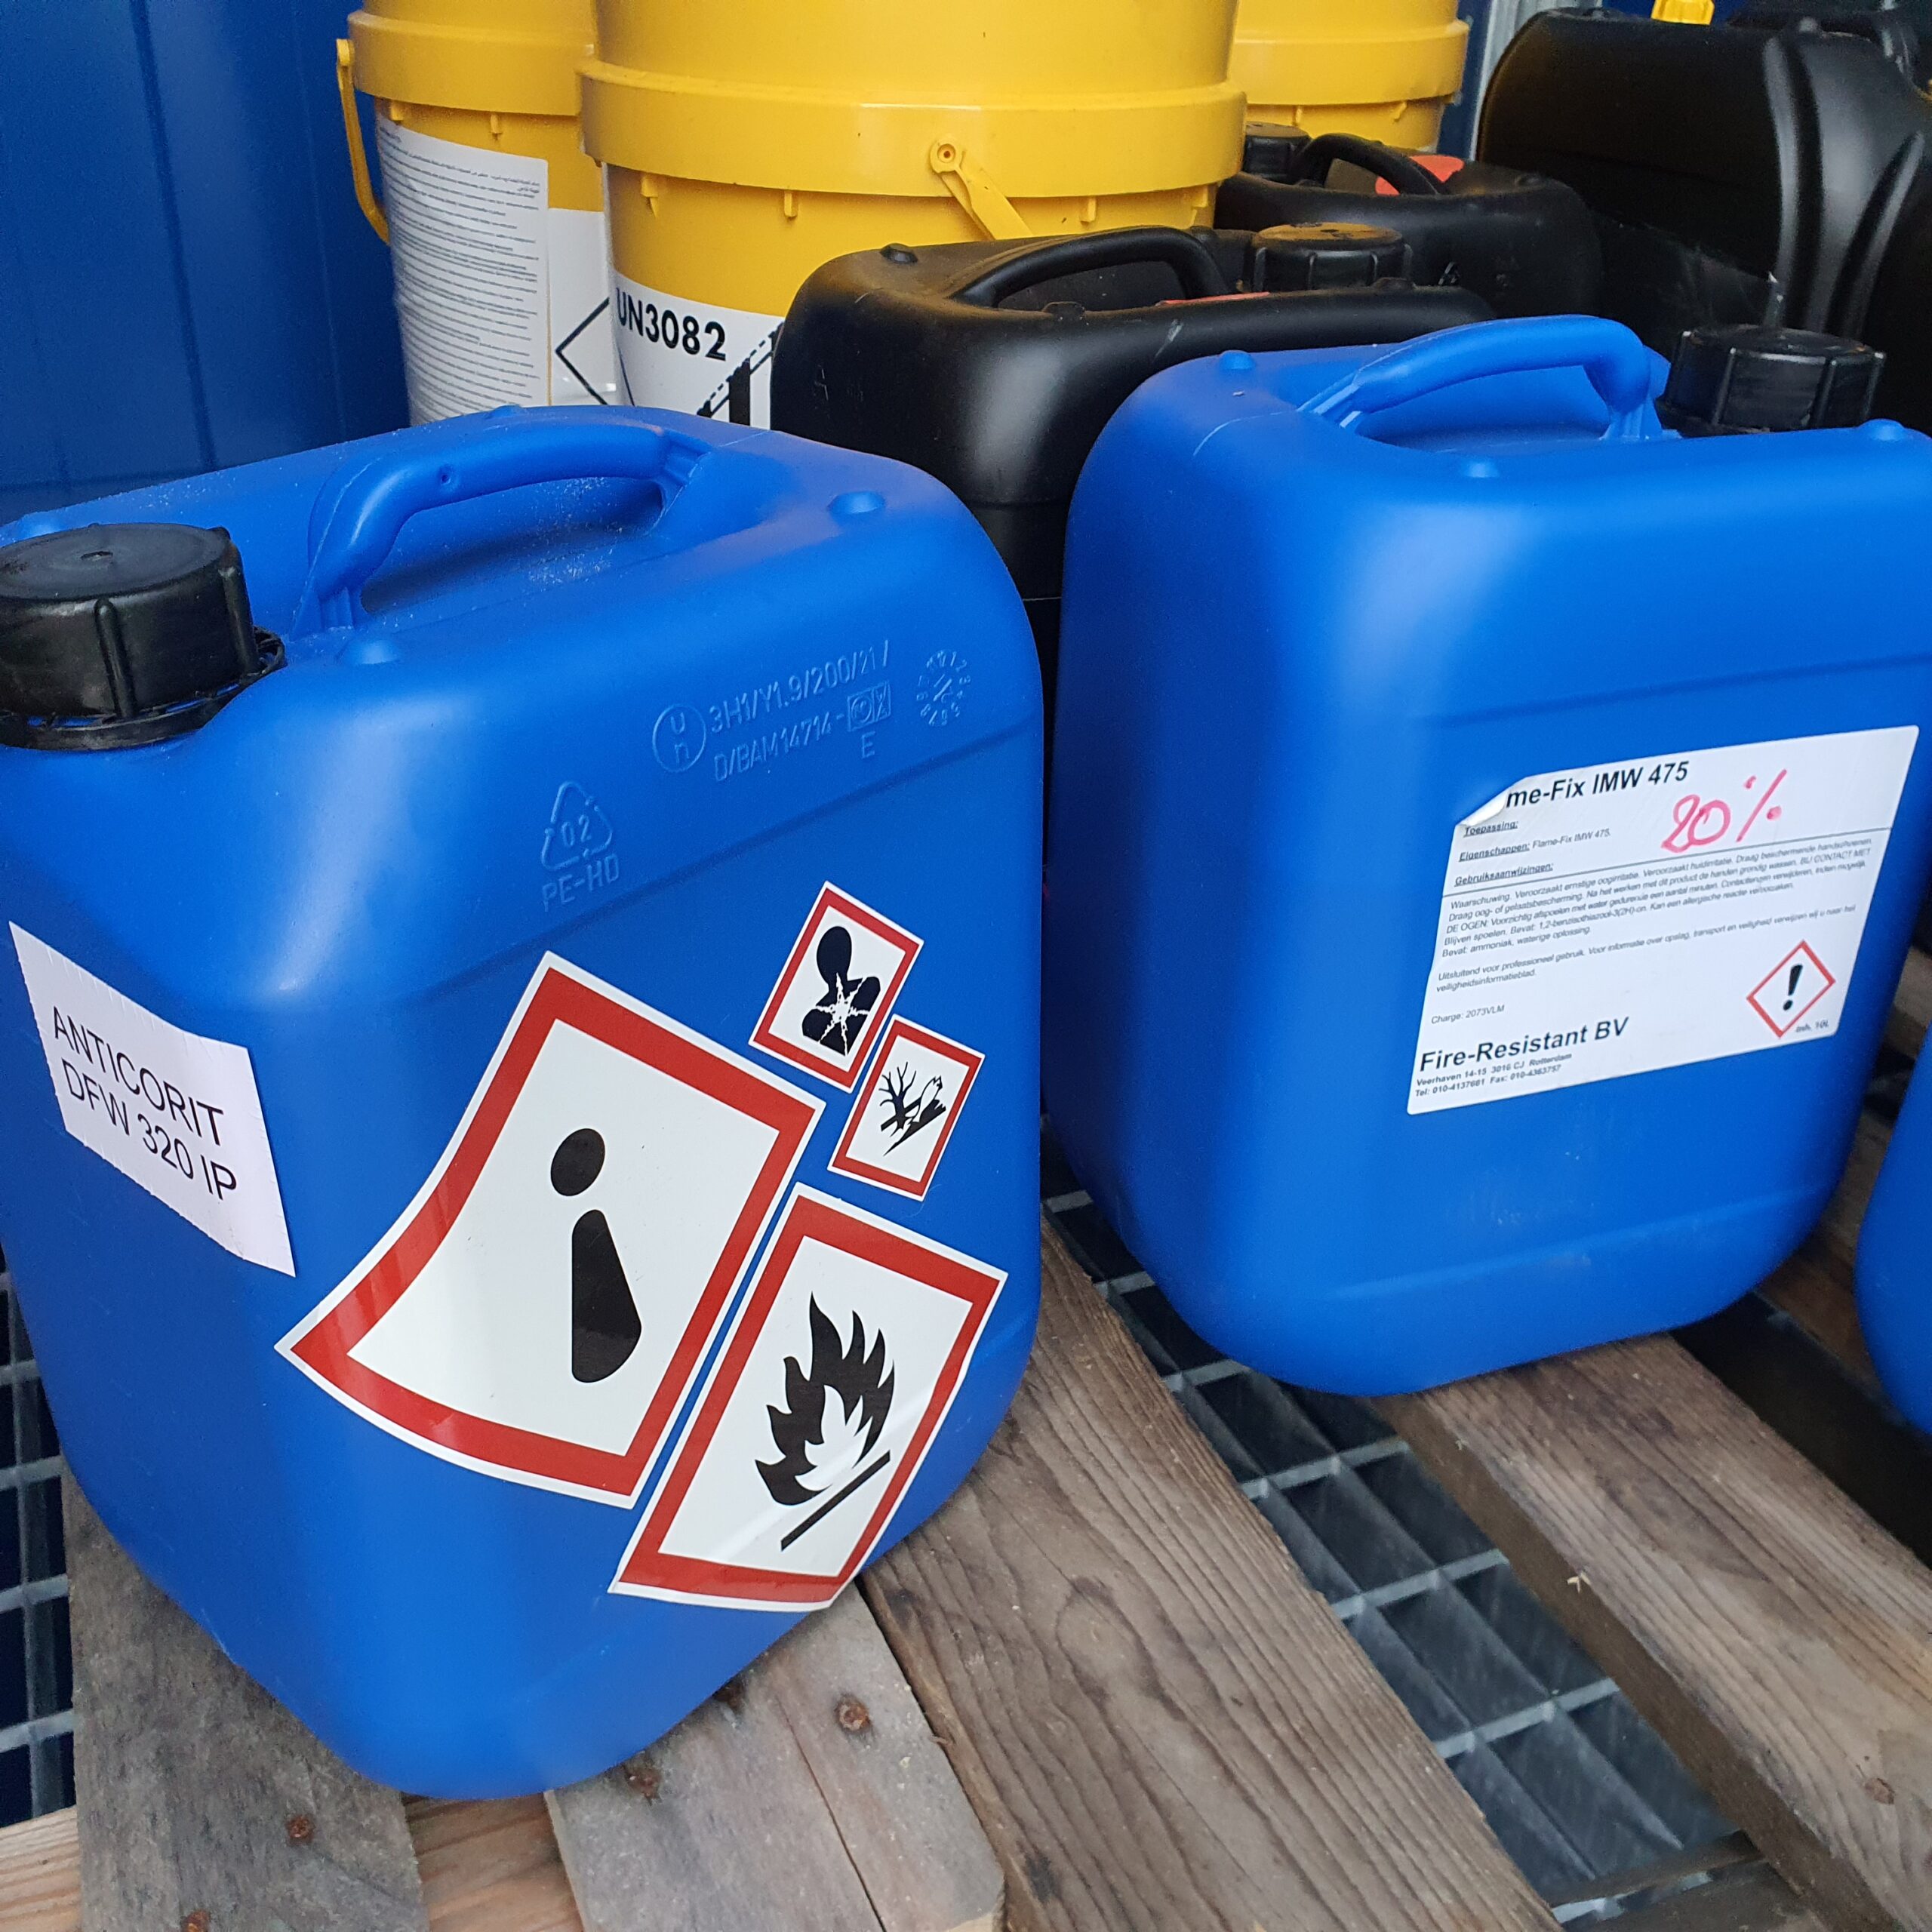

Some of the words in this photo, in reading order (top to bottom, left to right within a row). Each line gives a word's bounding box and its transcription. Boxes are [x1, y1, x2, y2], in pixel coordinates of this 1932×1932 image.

[616, 287, 726, 361] UN3082
[1506, 778, 1585, 808] me-Fix
[1592, 767, 1643, 794] IMW
[1648, 761, 1689, 785] 475
[561, 814, 590, 848] 02
[1464, 821, 1518, 837] Toepassing:
[1458, 843, 1530, 862] Eigenschappen:
[1532, 835, 1573, 849] Flame-Fix
[1574, 832, 1592, 842] IMW
[542, 854, 620, 912] PE-HD
[1454, 863, 1554, 888] Gebruiksaanwijzingen:
[1432, 1012, 1463, 1024] Charge:
[1466, 1004, 1505, 1019] 2073VLM
[1420, 1025, 1588, 1072] Fire-Resistant
[1594, 1017, 1629, 1040] BV
[54, 1006, 223, 1146] ANTICORIT
[1417, 1073, 1462, 1086] Veerhaven
[1465, 1068, 1487, 1078] 14-15
[1514, 1061, 1524, 1069] CJ
[1529, 1054, 1572, 1066] Rotterdam
[1415, 1088, 1430, 1097] Tel:
[61, 1058, 130, 1136] DFW
[137, 1113, 193, 1180] 320
[201, 1155, 237, 1200] IP
